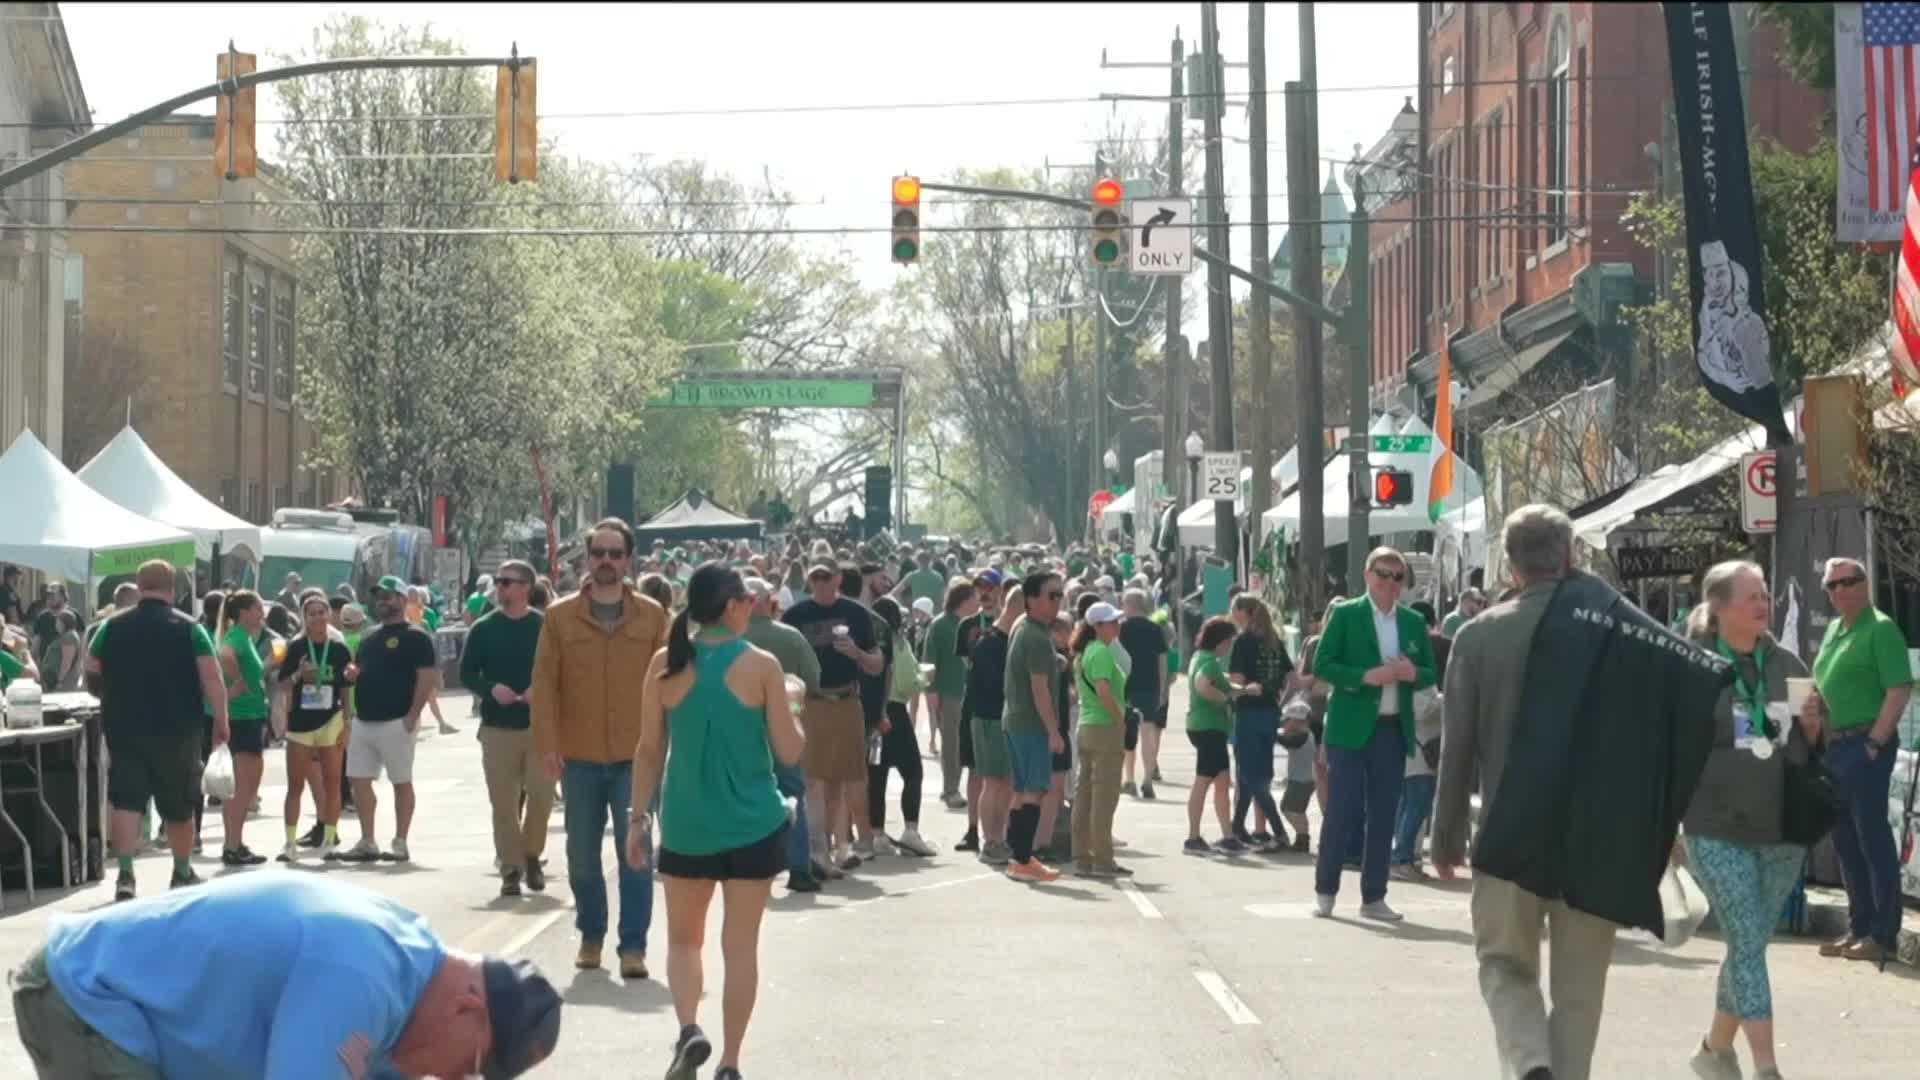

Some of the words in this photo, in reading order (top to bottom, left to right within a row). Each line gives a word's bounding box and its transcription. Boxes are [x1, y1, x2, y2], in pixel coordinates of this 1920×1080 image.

[1138, 251, 1184, 267] ONLY
[708, 385, 772, 400] BROWN
[775, 385, 828, 401] STAGE
[1207, 457, 1238, 466] SPEED
[1210, 467, 1235, 476] LIMIT
[1208, 476, 1237, 494] 25
[1622, 555, 1656, 572] PAY
